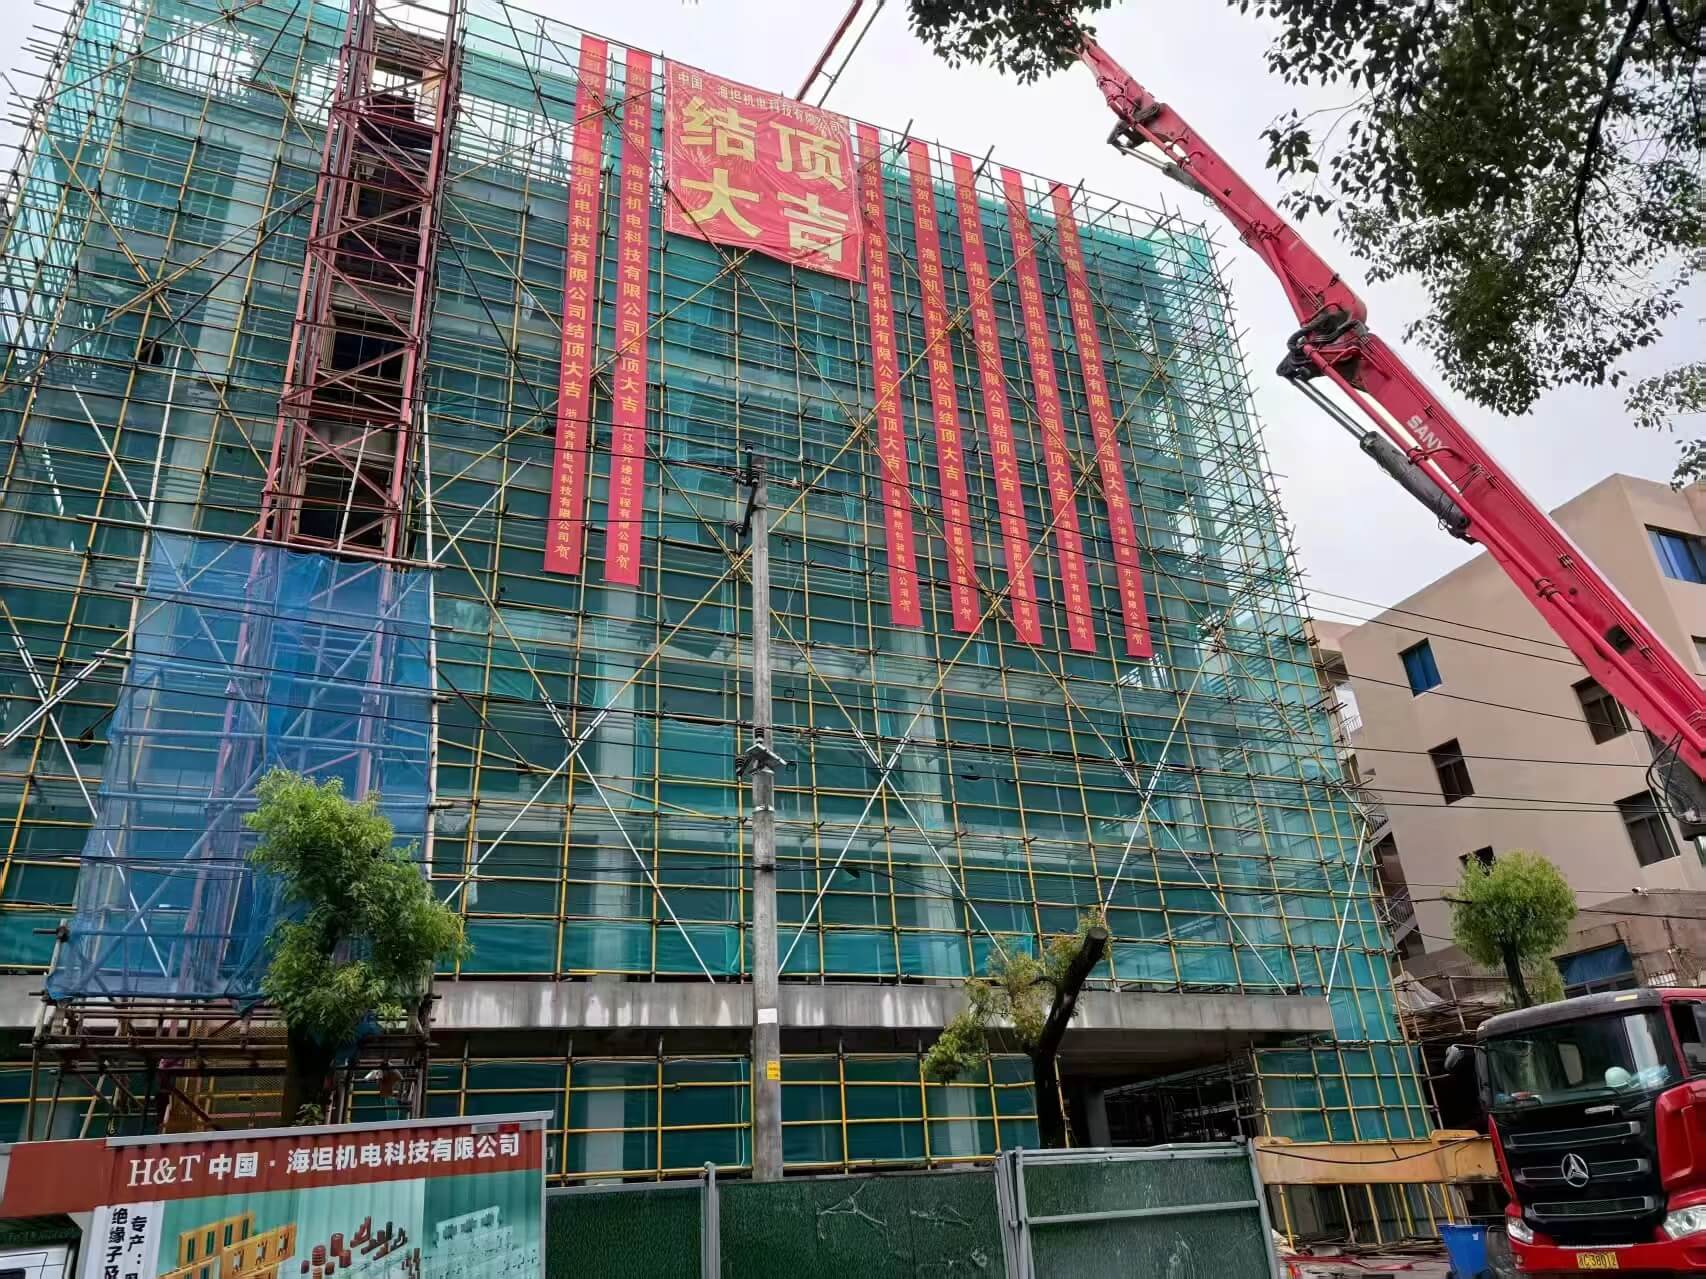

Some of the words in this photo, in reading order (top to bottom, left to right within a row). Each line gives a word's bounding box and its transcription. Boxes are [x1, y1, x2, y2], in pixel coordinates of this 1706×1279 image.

[680, 96, 847, 191] 结顶
[680, 168, 849, 262] 大吉
[127, 1155, 201, 1187] H&T
